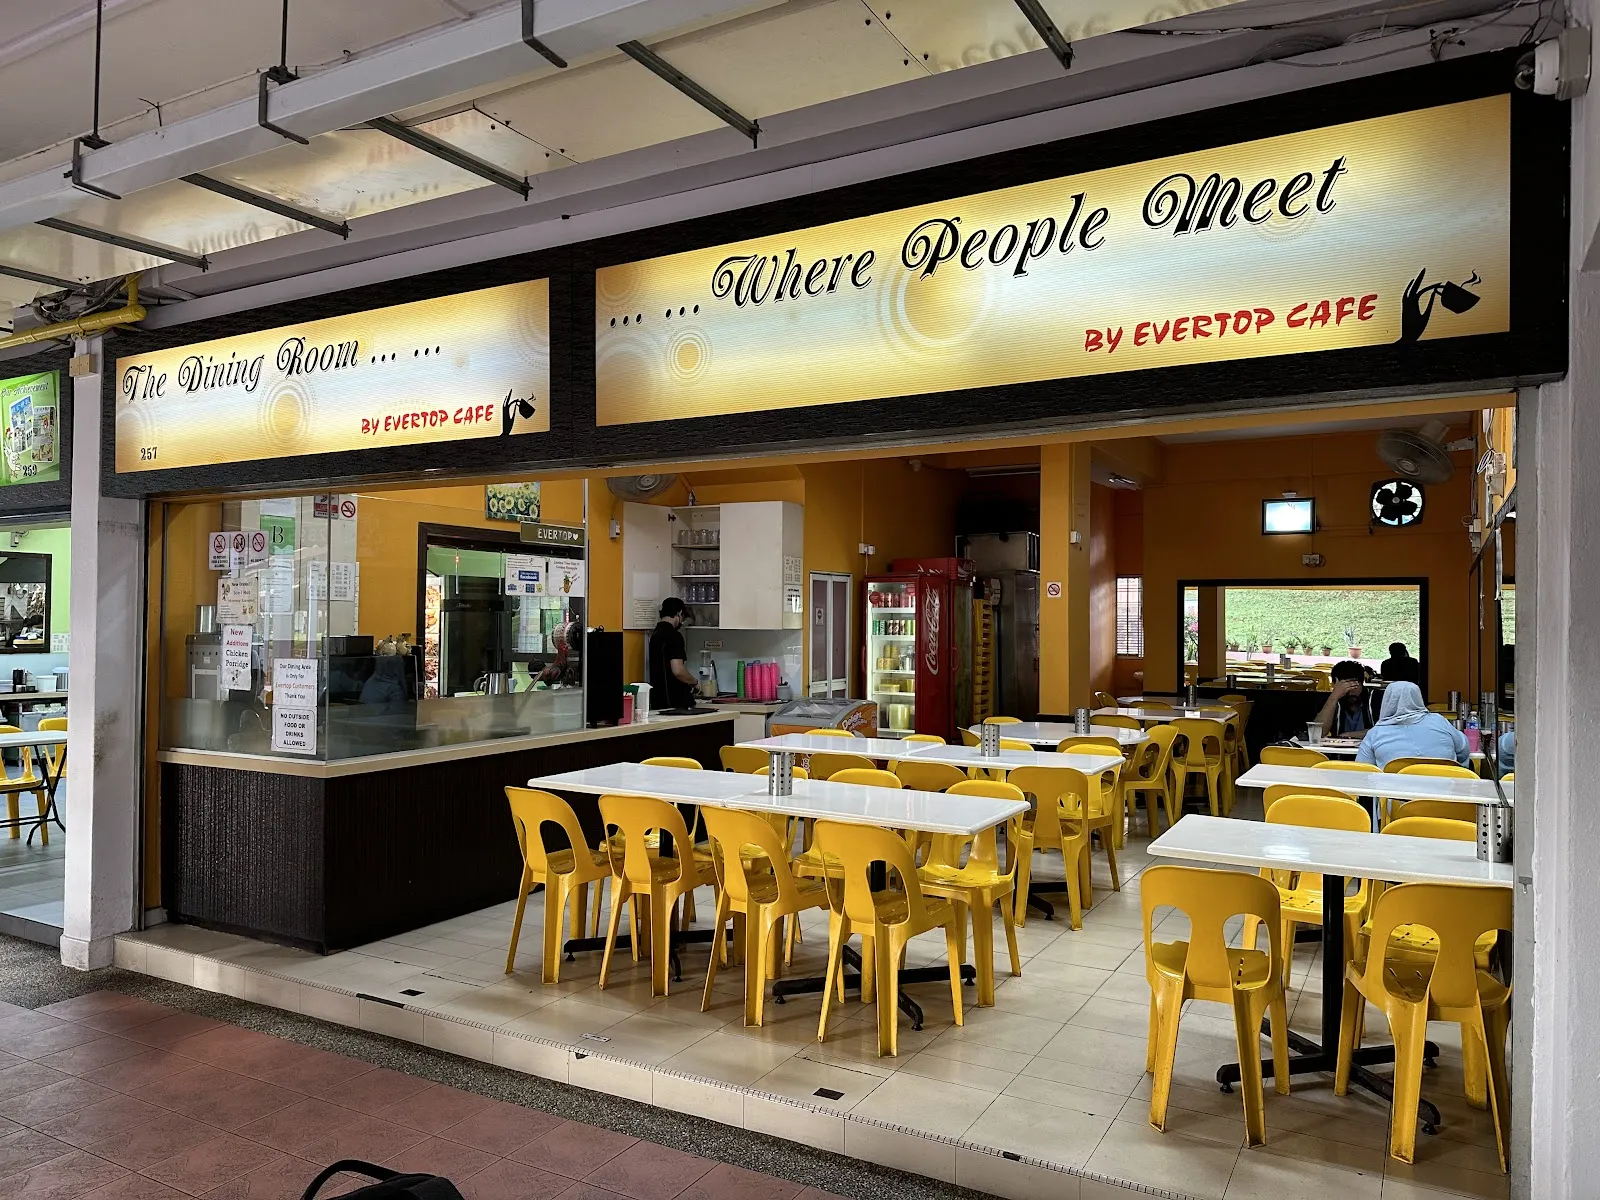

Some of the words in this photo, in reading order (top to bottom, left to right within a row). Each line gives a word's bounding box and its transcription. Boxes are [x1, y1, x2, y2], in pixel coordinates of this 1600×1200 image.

[711, 247, 876, 308] Where
[901, 191, 1111, 281] People
[1141, 155, 1348, 238] Meet
[1084, 327, 1124, 353] BY
[1133, 306, 1276, 347] EVERTOP
[1286, 294, 1379, 330] CAFE
[122, 365, 167, 404] The
[178, 350, 265, 396] Dining
[276, 336, 359, 379] Room
[361, 418, 380, 436] BY
[384, 409, 449, 432] EVERTOP
[453, 404, 495, 425] CAFE
[140, 446, 158, 461] 257
[22, 464, 38, 477] 259
[273, 525, 284, 543] B
[537, 528, 573, 540] EVERTOP
[225, 650, 248, 658] Chicken
[225, 660, 249, 670] Porridge
[288, 663, 301, 671] Dining
[275, 682, 292, 692] Evertop
[292, 682, 316, 691] Customers
[288, 712, 310, 721] OUTSIDE
